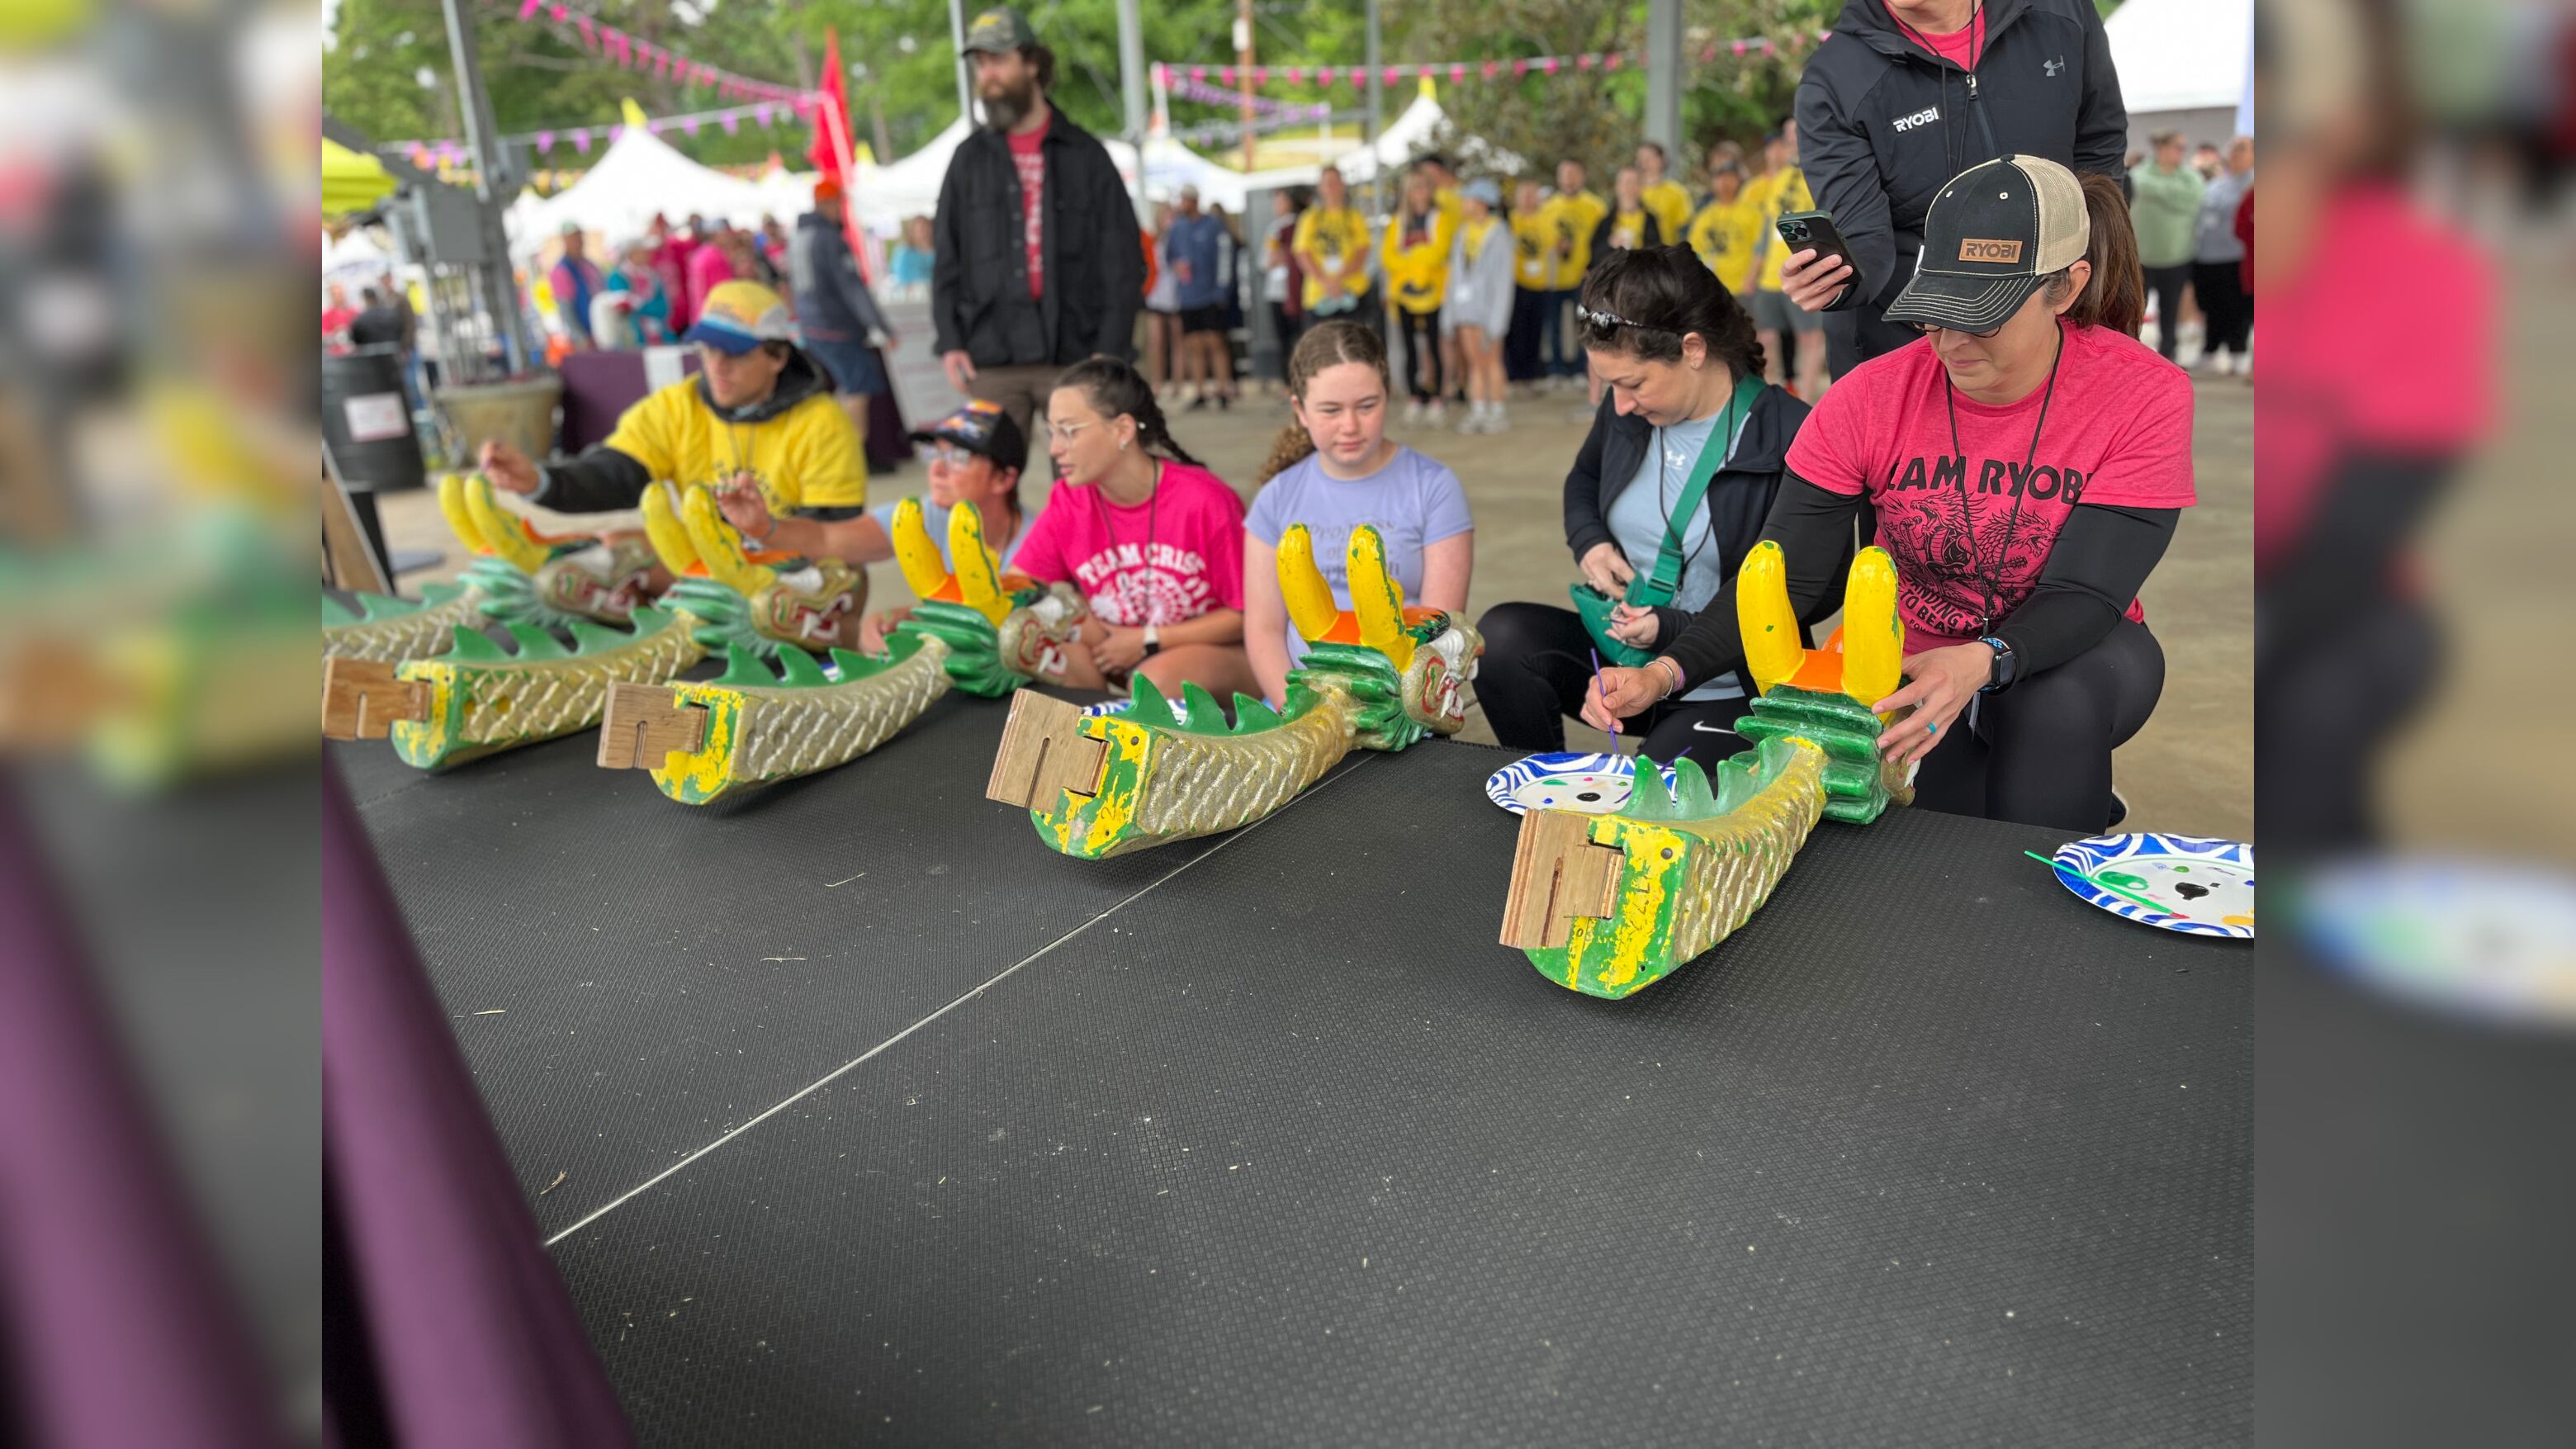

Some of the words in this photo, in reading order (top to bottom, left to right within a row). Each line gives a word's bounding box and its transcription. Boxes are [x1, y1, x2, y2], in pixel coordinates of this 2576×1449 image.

[1892, 107, 1939, 132] RYOBI
[1965, 242, 2018, 258] RYOBI
[1076, 542, 1143, 586] TEAM
[1900, 589, 1920, 609] TO
